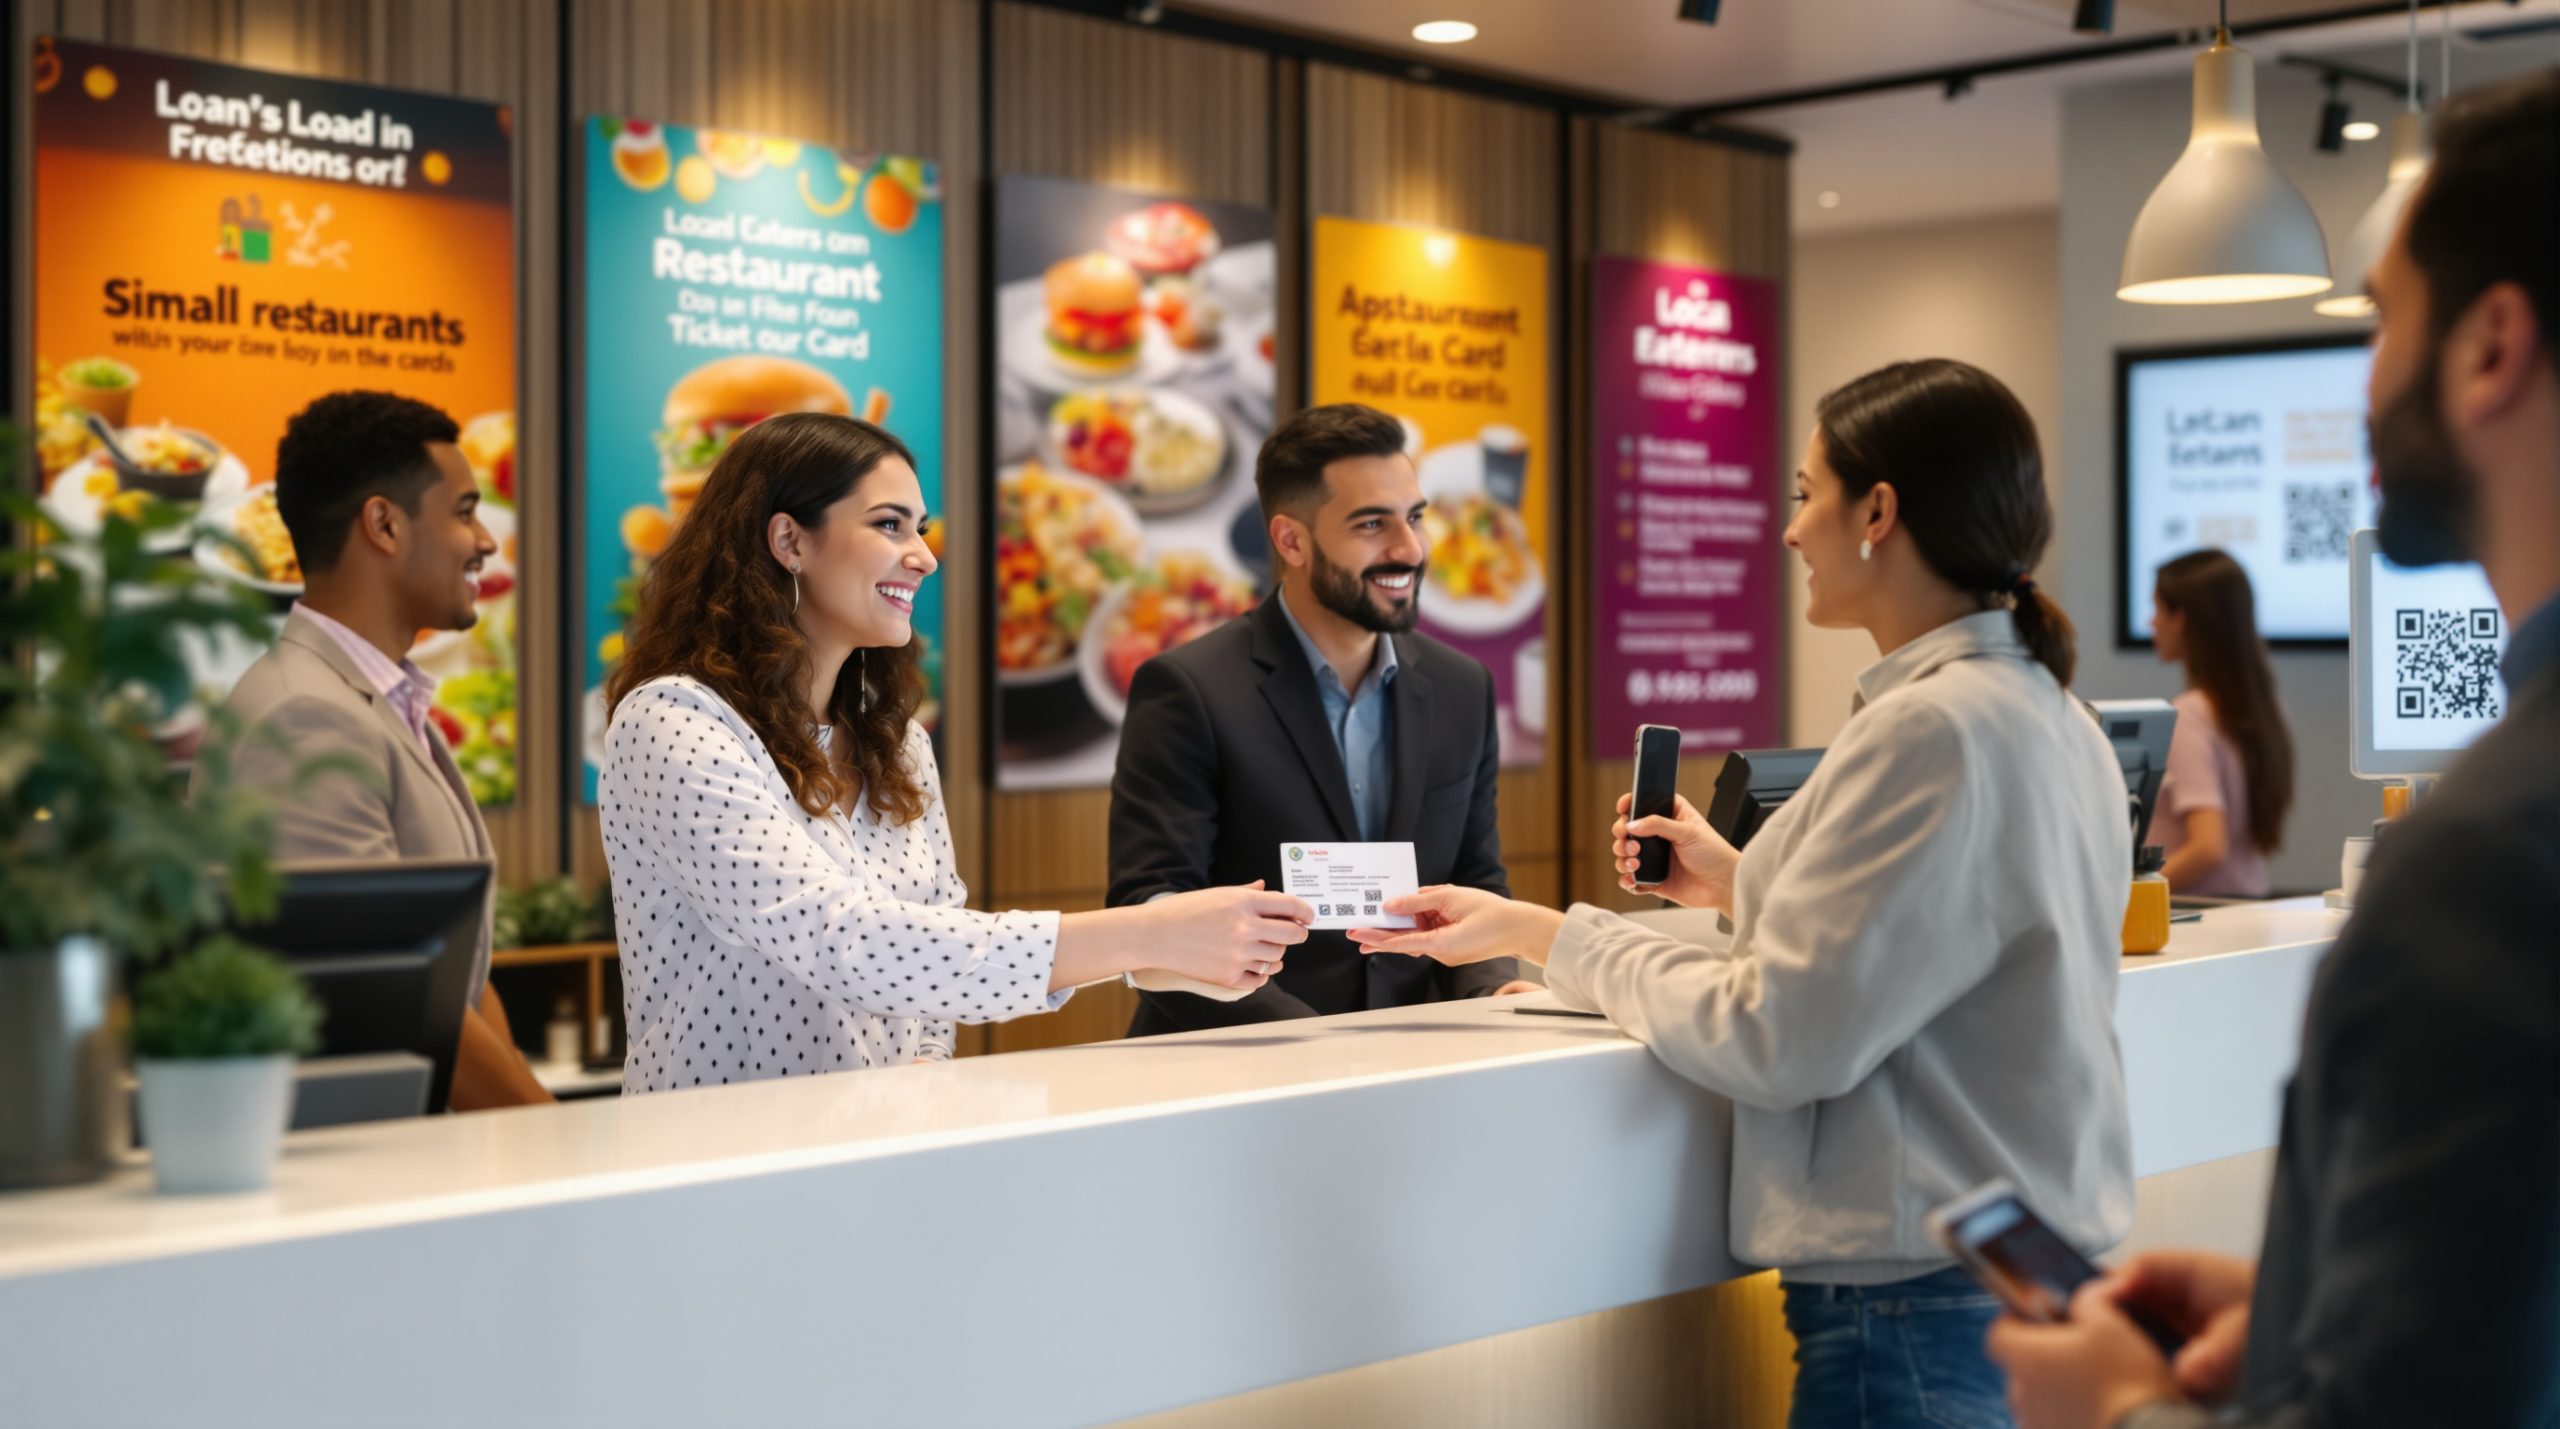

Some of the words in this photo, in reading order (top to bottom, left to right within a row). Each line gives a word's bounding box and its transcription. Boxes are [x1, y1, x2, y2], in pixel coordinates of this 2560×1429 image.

[156, 79, 284, 134] Loan's
[288, 99, 375, 146] Load
[380, 114, 414, 150] in
[653, 236, 882, 303] Restaurant
[103, 278, 239, 327] Simall
[253, 298, 465, 347] restaurants
[806, 326, 871, 361] Card
[178, 332, 232, 355] your
[358, 343, 391, 370] the
[399, 349, 456, 374] cards
